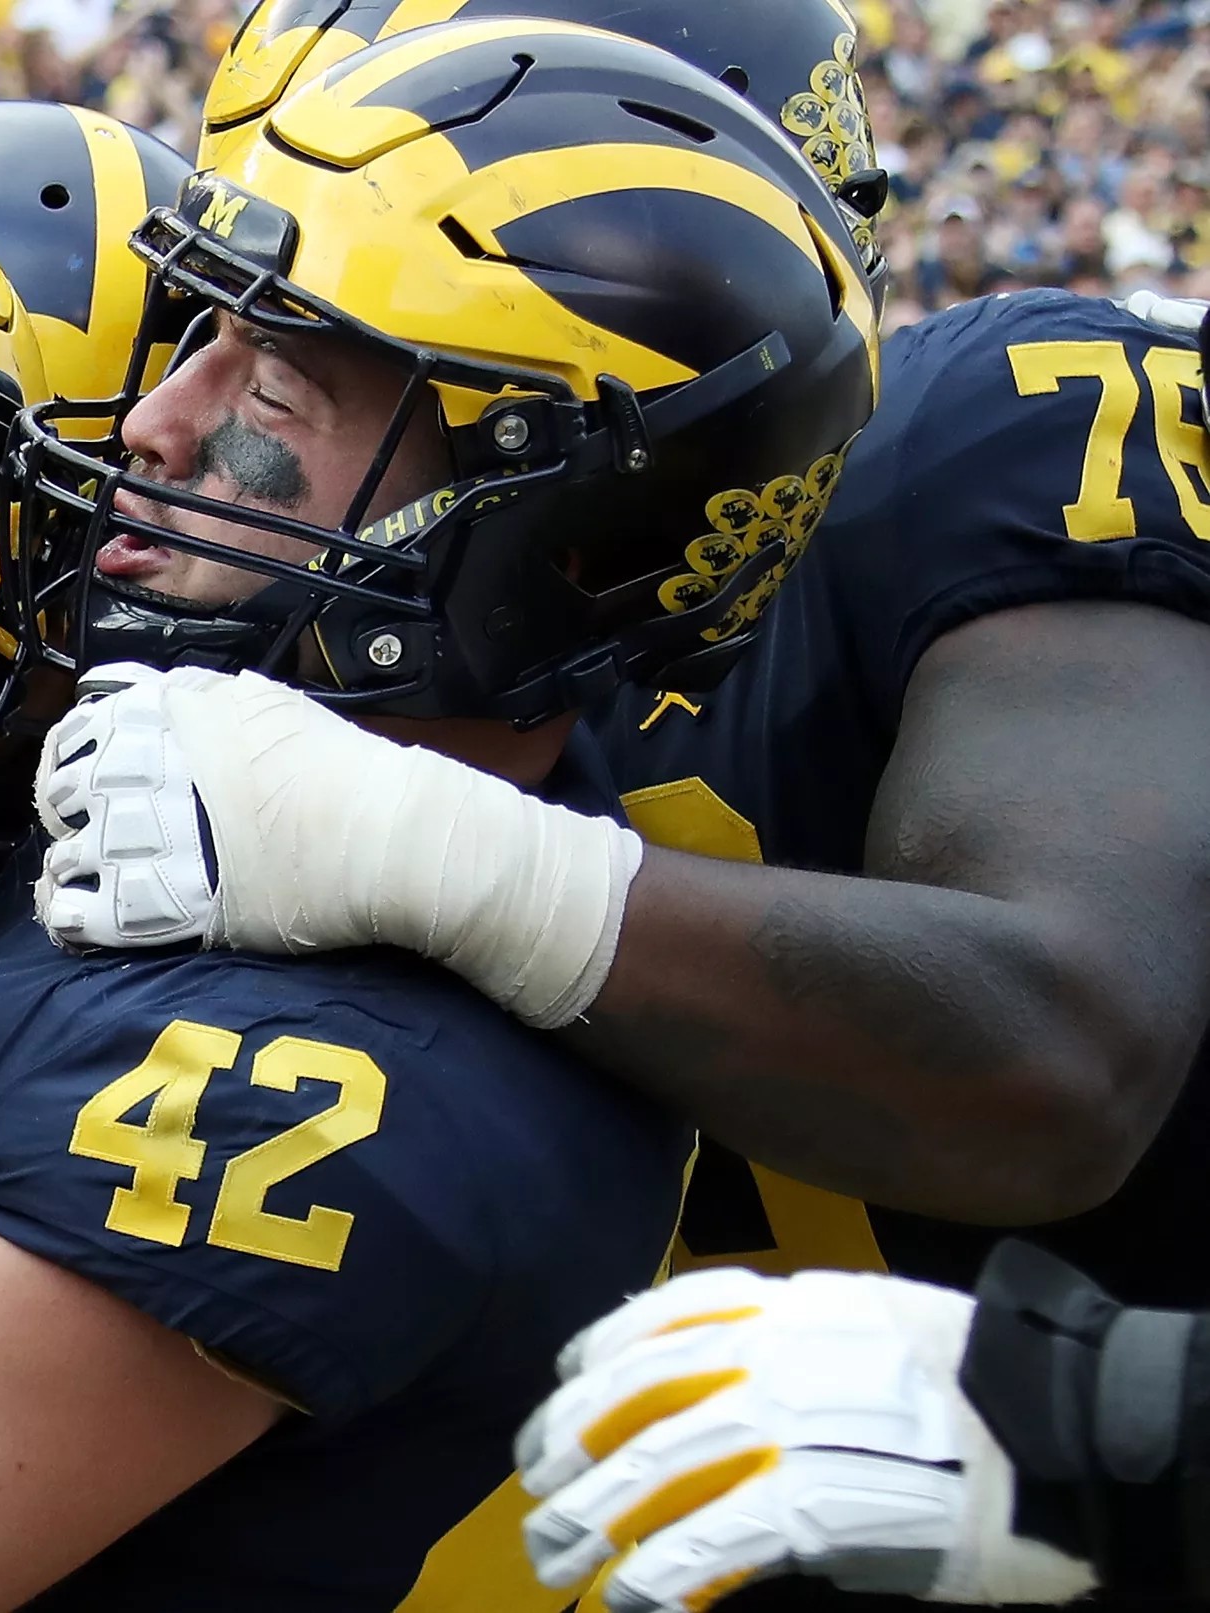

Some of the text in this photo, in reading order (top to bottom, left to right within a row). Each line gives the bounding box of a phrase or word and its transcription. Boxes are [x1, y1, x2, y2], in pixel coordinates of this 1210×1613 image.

[198, 187, 249, 239] M
[1006, 341, 1210, 541] 76
[68, 1019, 388, 1272] 42
